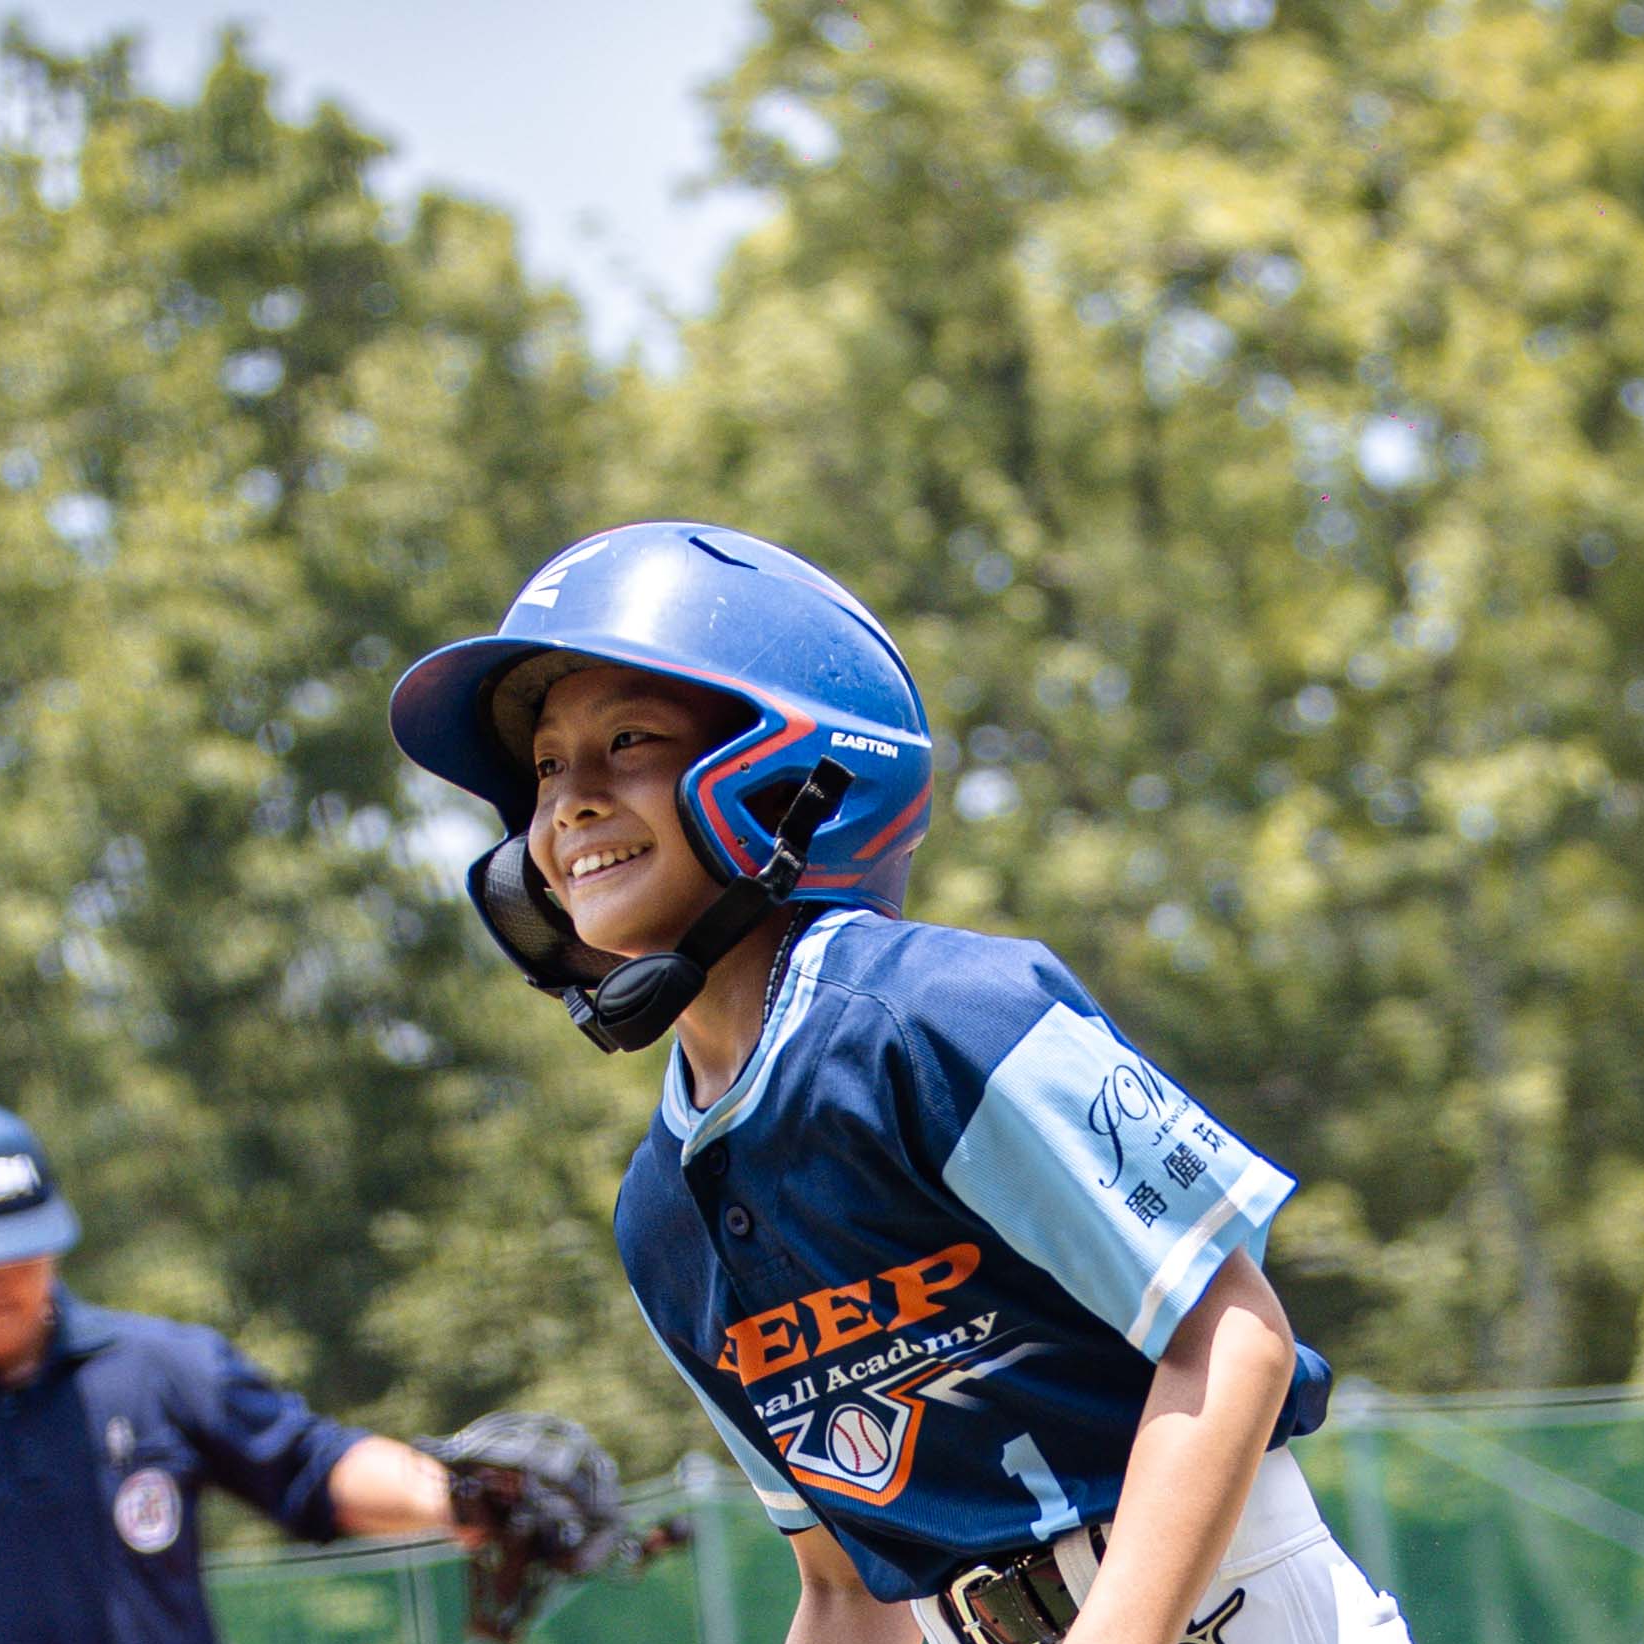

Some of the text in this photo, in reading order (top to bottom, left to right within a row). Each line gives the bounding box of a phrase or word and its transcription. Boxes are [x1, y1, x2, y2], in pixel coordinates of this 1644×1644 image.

[831, 731, 899, 759] EASTON
[716, 1243, 981, 1387] EEP
[826, 1310, 999, 1393] Acadmy
[1001, 1432, 1081, 1542] 1
